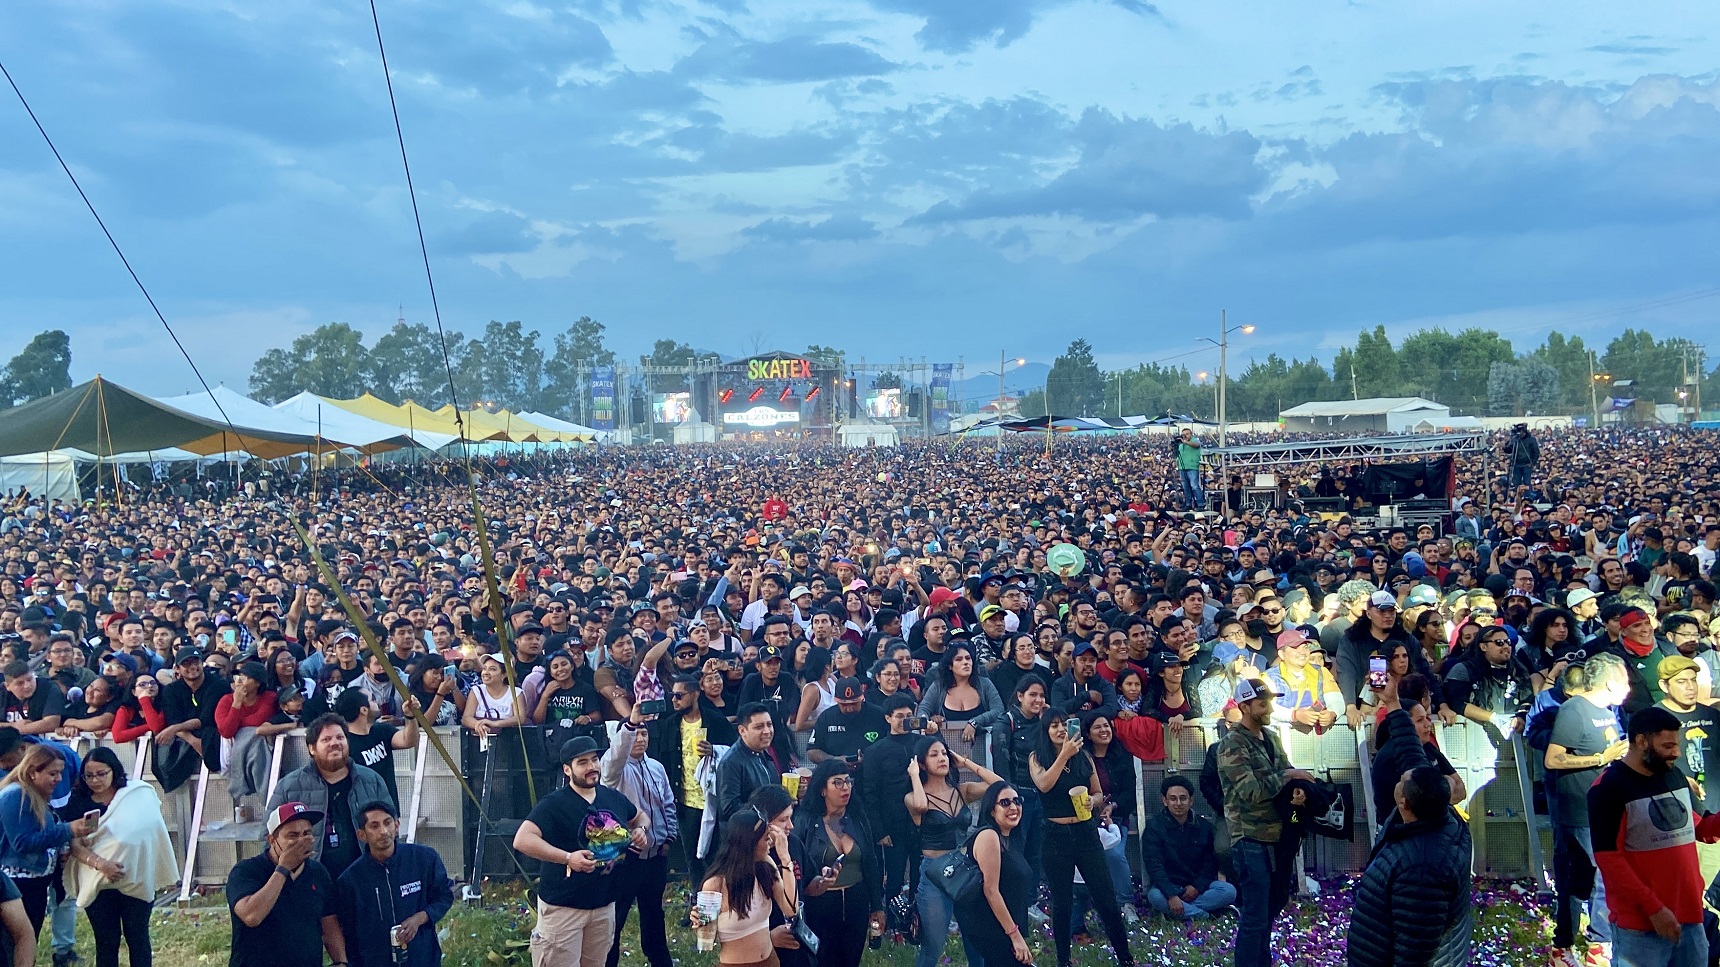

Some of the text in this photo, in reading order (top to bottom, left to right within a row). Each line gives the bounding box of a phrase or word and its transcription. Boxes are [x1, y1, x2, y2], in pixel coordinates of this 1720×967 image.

[748, 359, 812, 380] SKATEX
[728, 413, 796, 421] CALZONES
[548, 696, 584, 704] ARILYN
[361, 741, 388, 766] DKNY
